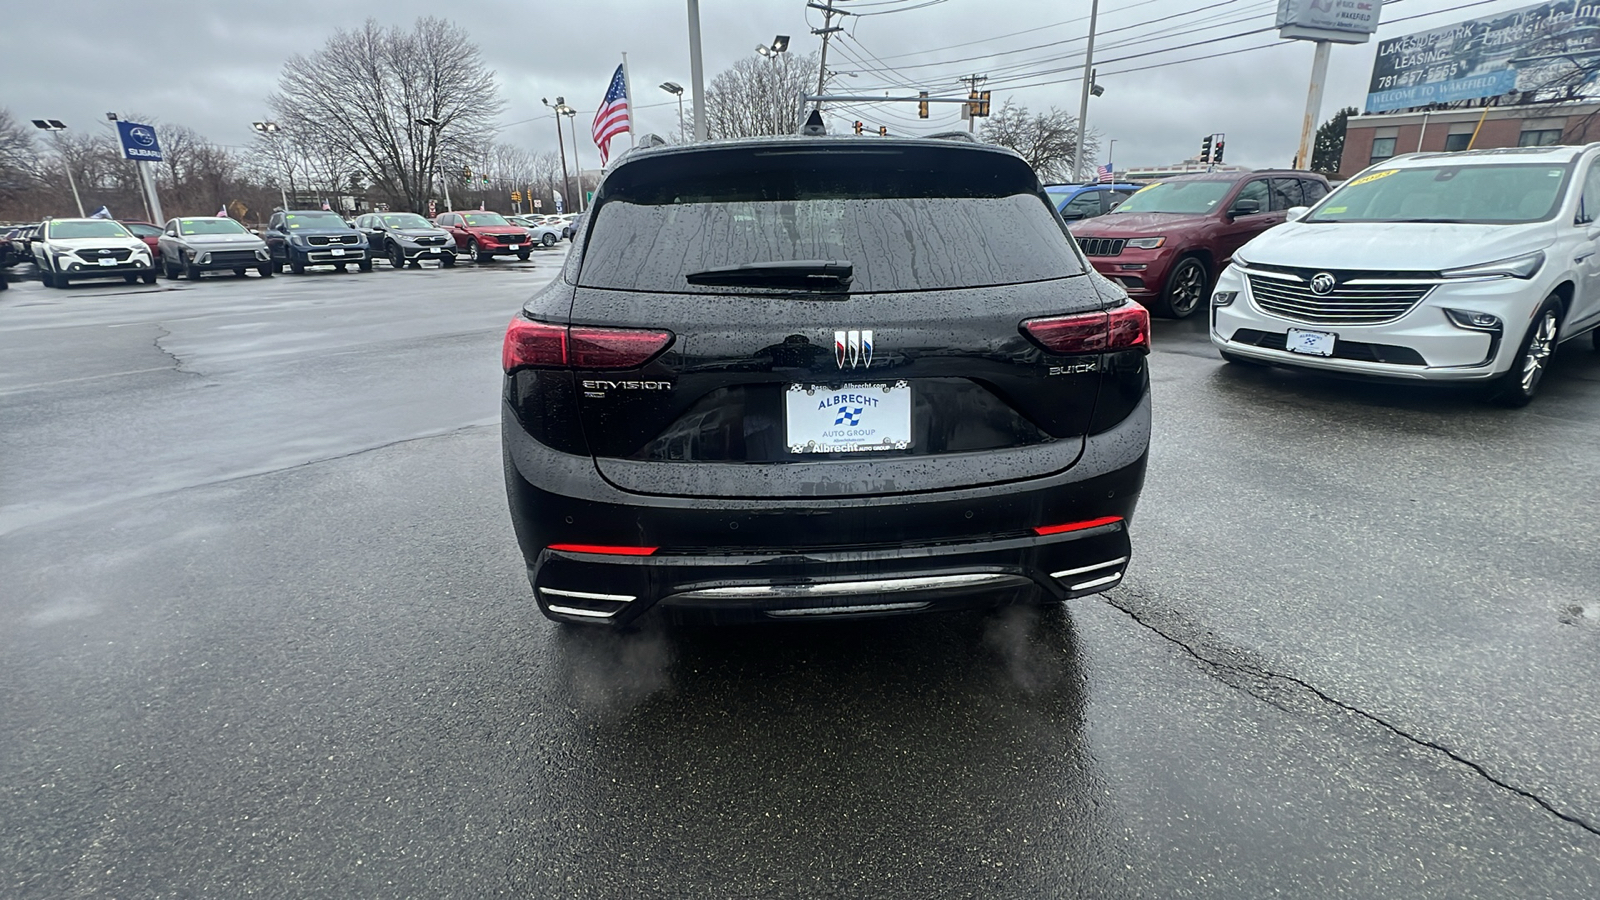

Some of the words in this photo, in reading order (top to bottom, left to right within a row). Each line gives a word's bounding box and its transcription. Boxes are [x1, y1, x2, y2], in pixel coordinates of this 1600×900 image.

[1341, 12, 1371, 22] WAKEFIELD
[1380, 34, 1436, 57] LAKESIDE
[1439, 24, 1473, 41] PARK
[1394, 48, 1446, 70] LEASING
[1373, 89, 1416, 104] WELCOME
[1421, 86, 1435, 98] TO
[1440, 76, 1496, 94] WAKEFIELD
[128, 148, 161, 158] SUBARU
[1049, 363, 1096, 376] BUICK
[582, 380, 671, 390] ENVISION
[818, 394, 879, 410] ALBRECHT
[822, 430, 845, 438] AUTO
[846, 429, 876, 437] GROUP
[812, 442, 858, 454] Albrecht
